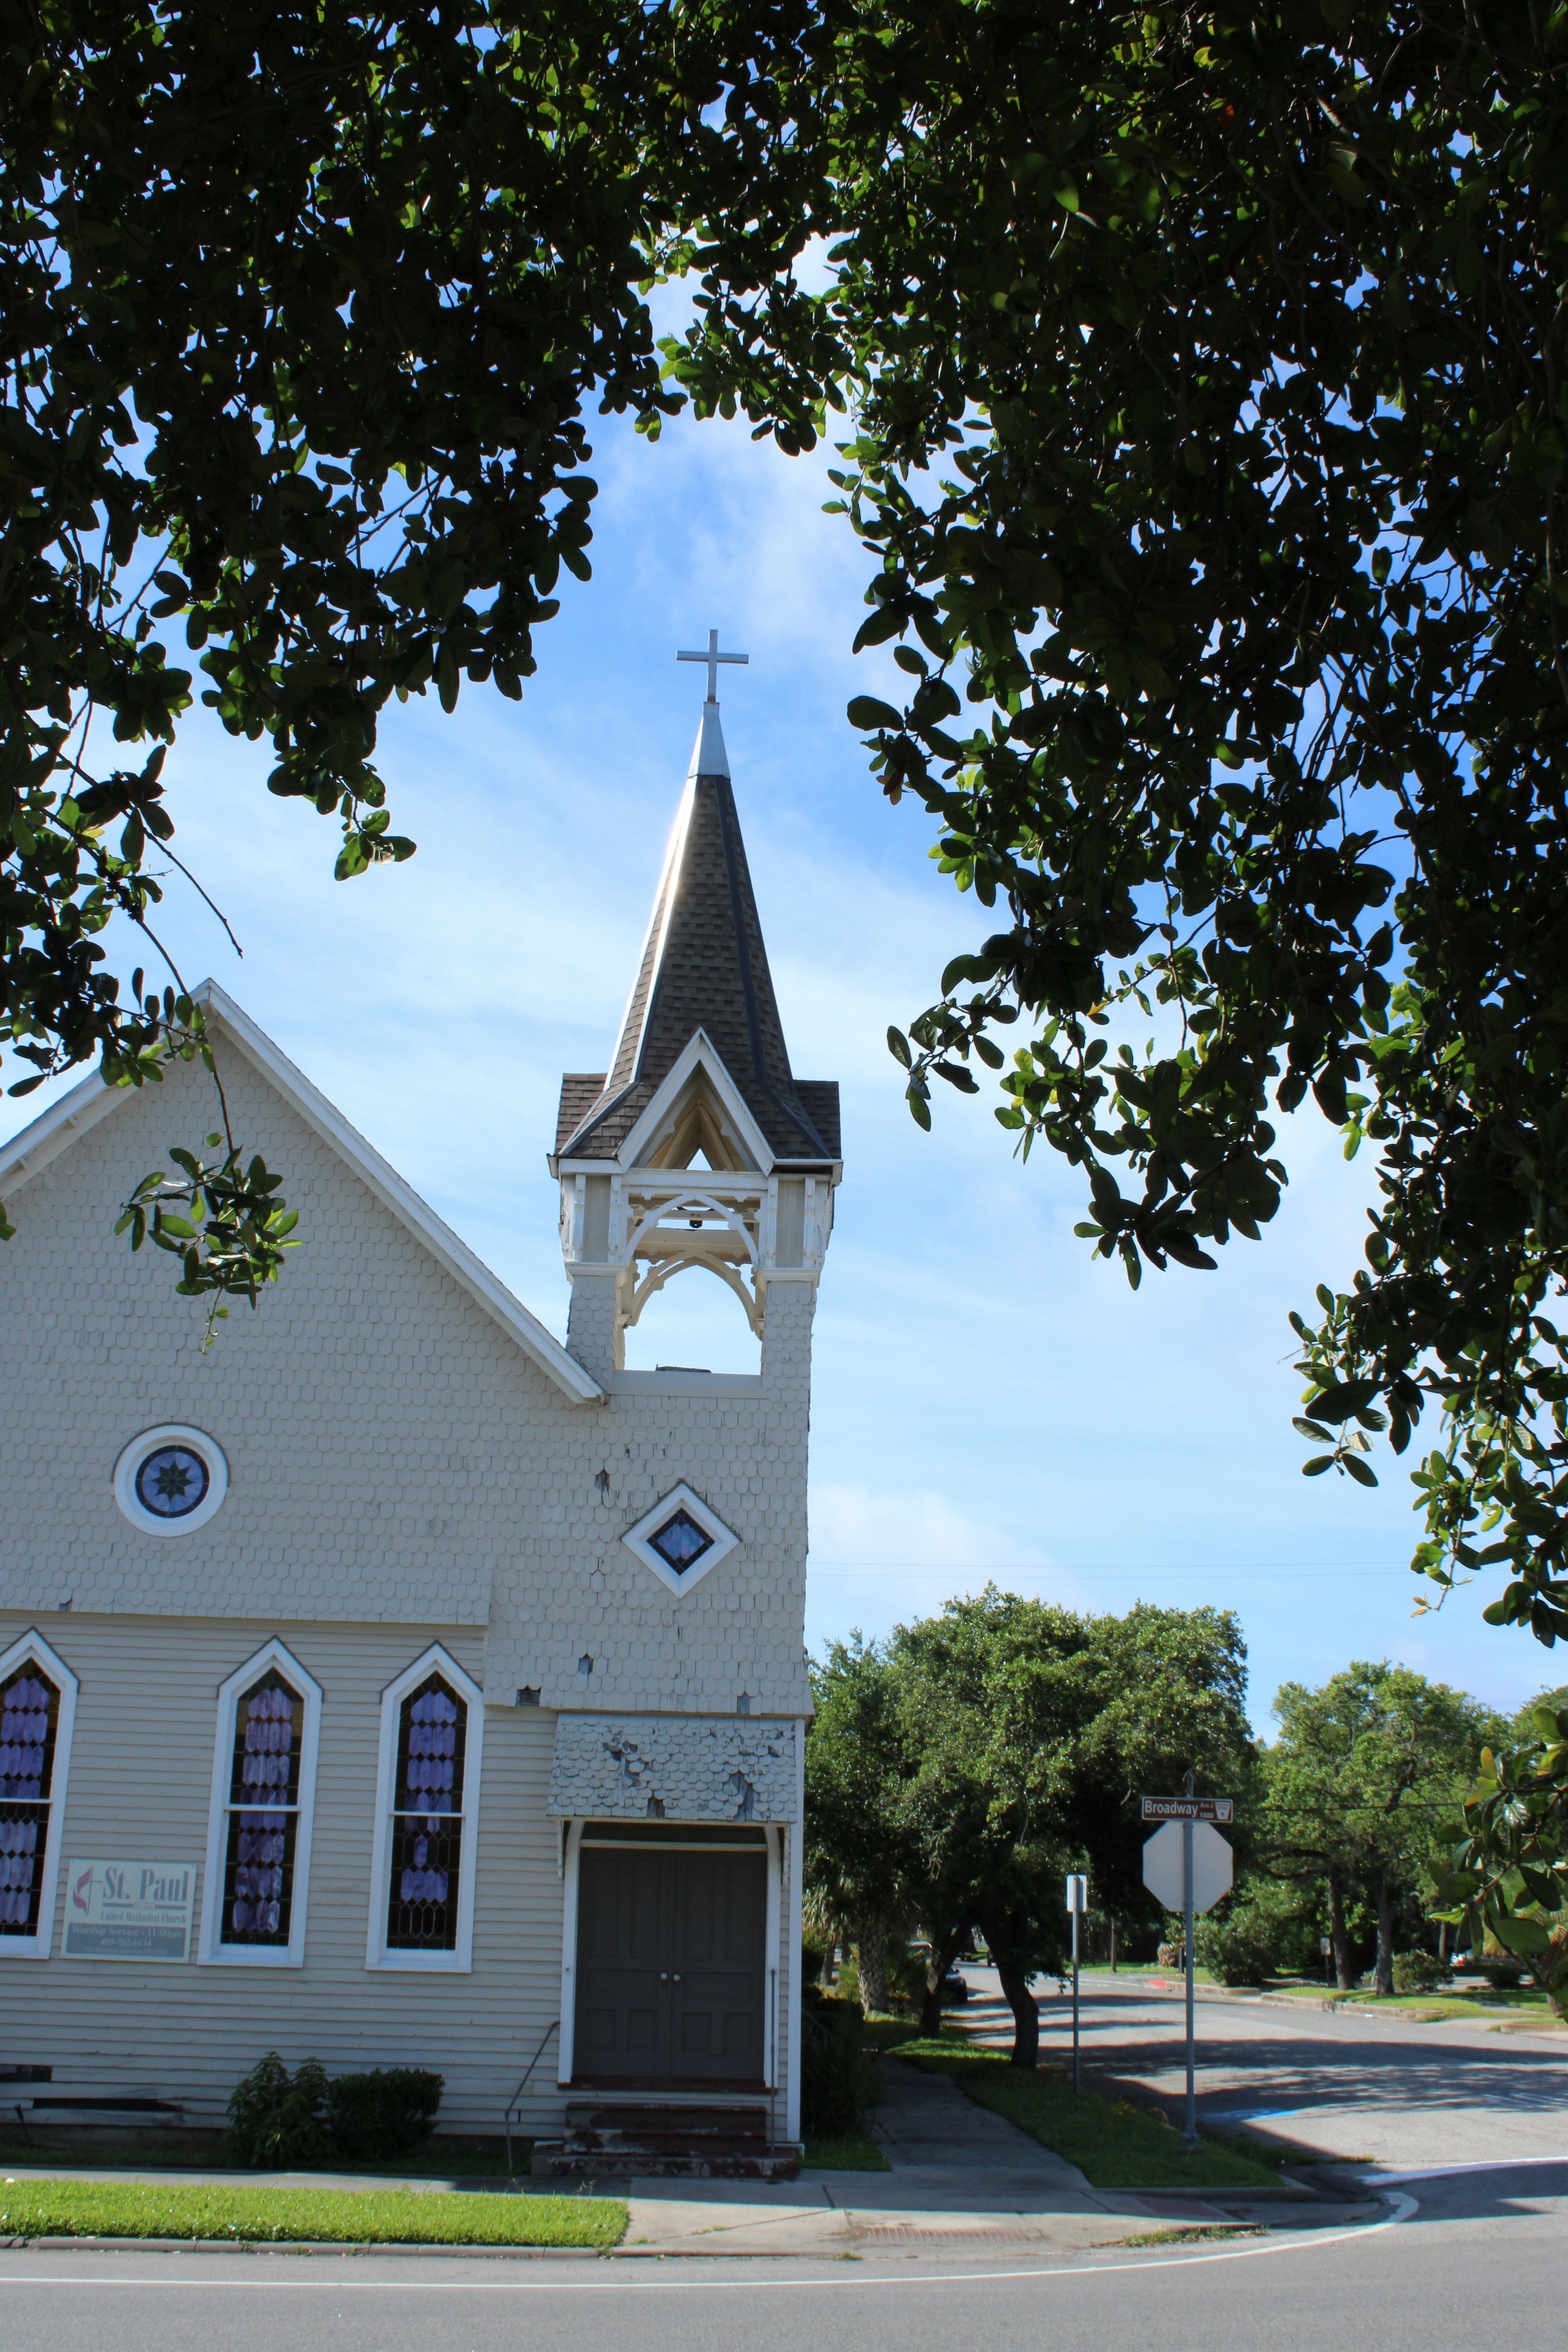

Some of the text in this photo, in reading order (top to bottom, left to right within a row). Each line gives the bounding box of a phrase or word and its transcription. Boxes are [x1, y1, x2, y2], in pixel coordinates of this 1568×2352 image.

[1144, 1800, 1198, 1818] Broadway
[103, 1867, 189, 1901] St. Paul
[101, 1911, 186, 1923] United Methodist Church
[73, 1925, 106, 1937] Worship
[109, 1926, 139, 1936] Service
[149, 1928, 182, 1938] 11:00am
